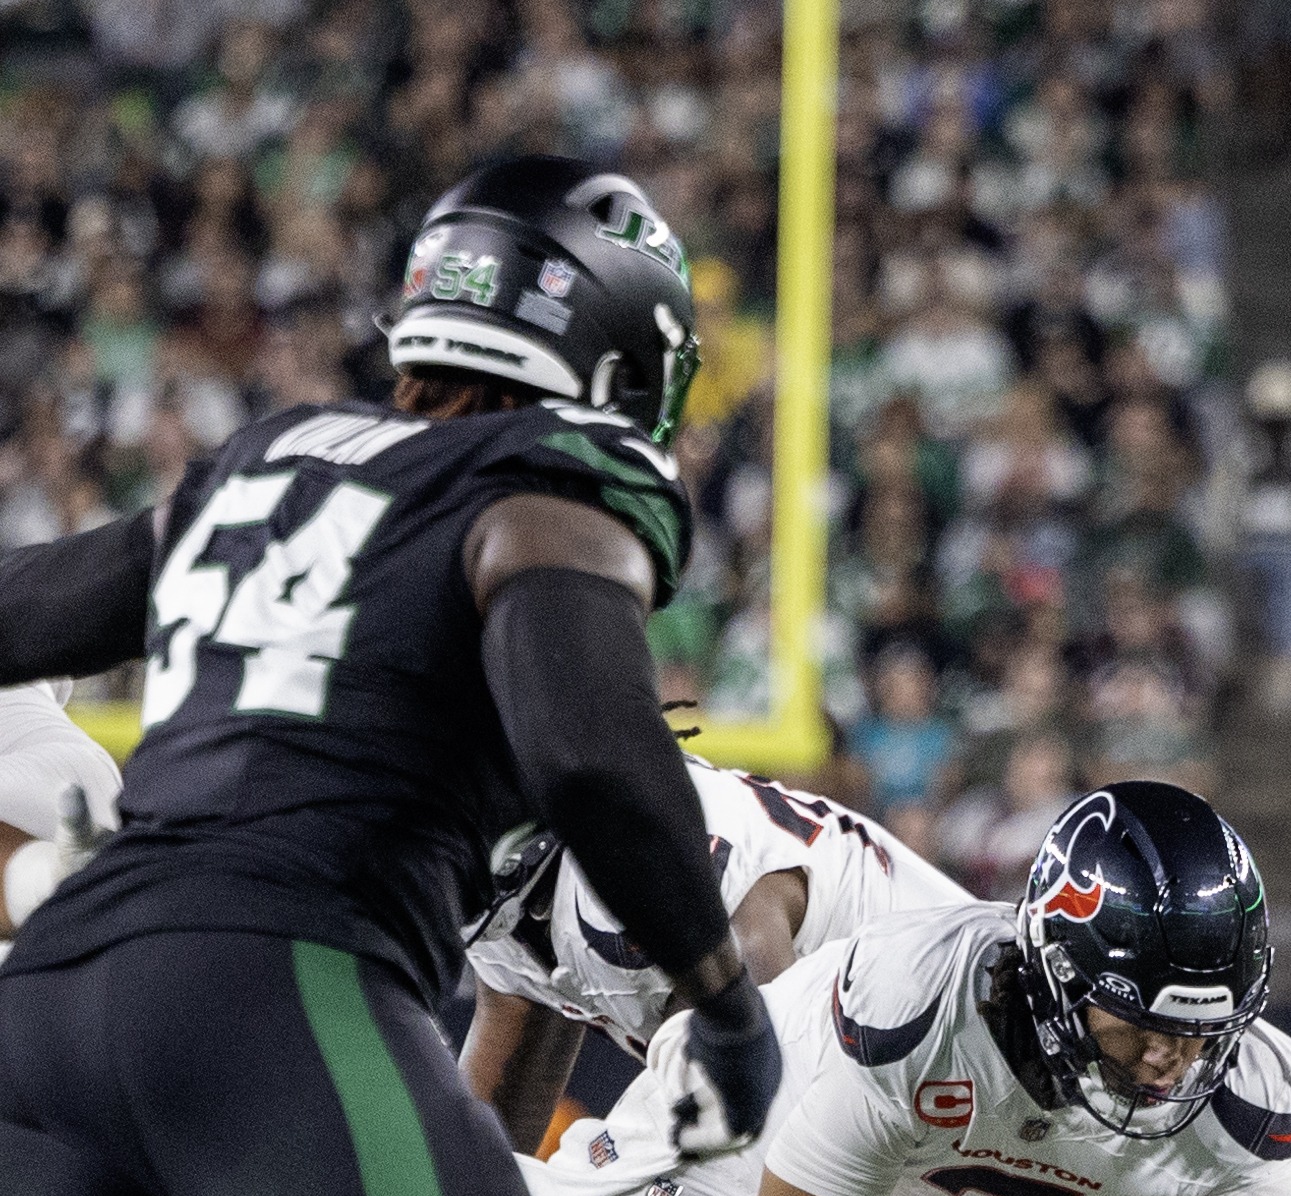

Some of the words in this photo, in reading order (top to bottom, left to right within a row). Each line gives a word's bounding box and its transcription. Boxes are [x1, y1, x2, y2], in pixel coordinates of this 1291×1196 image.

[431, 252, 500, 307] 54
[142, 469, 395, 730] 54
[919, 1084, 972, 1119] C
